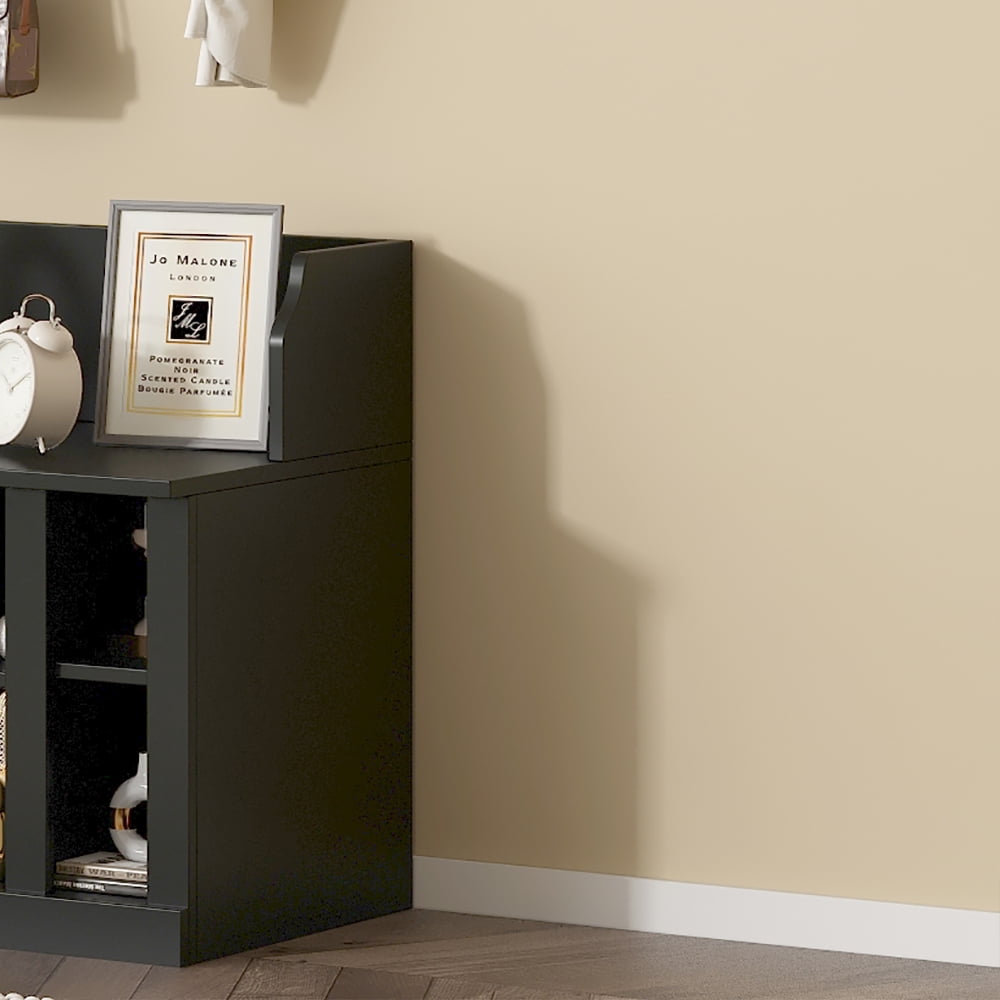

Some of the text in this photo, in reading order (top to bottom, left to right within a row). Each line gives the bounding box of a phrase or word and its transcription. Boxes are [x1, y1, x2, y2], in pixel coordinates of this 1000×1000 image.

[177, 255, 238, 267] MALONE
[169, 273, 216, 282] LONDON
[149, 355, 224, 365] POMEGRANATE
[174, 366, 199, 374] NOIR
[140, 374, 230, 385] SCENTED CANDLE
[137, 384, 175, 394] BOUGIE
